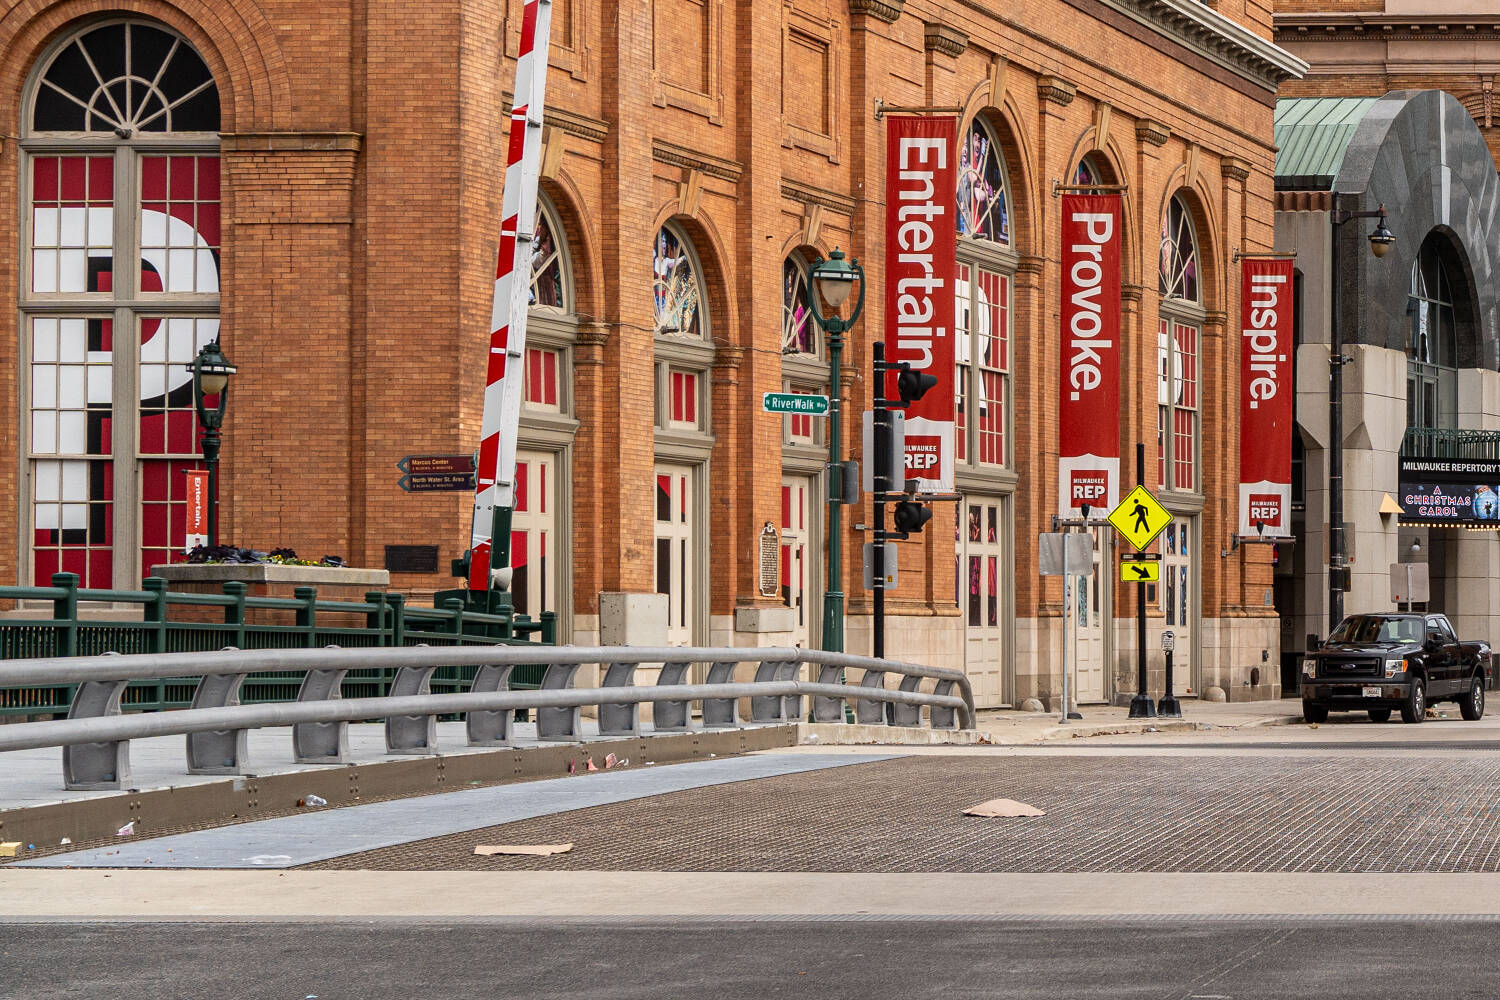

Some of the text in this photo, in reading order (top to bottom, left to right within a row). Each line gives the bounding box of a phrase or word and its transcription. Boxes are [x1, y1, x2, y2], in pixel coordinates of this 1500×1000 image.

[897, 137, 947, 381] Entertain
[1070, 212, 1113, 401] Provoke.
[1242, 275, 1287, 409] Inspire.
[772, 397, 814, 410] RiverWalk
[904, 453, 938, 469] REP
[1403, 462, 1450, 471] MILWAUKEE
[1451, 463, 1497, 473] REPERTORY
[1073, 485, 1106, 499] REP
[1432, 485, 1442, 495] A
[1405, 495, 1472, 506] CHRISTMAS
[1251, 507, 1279, 519] REP
[1418, 506, 1458, 517] CAROL
